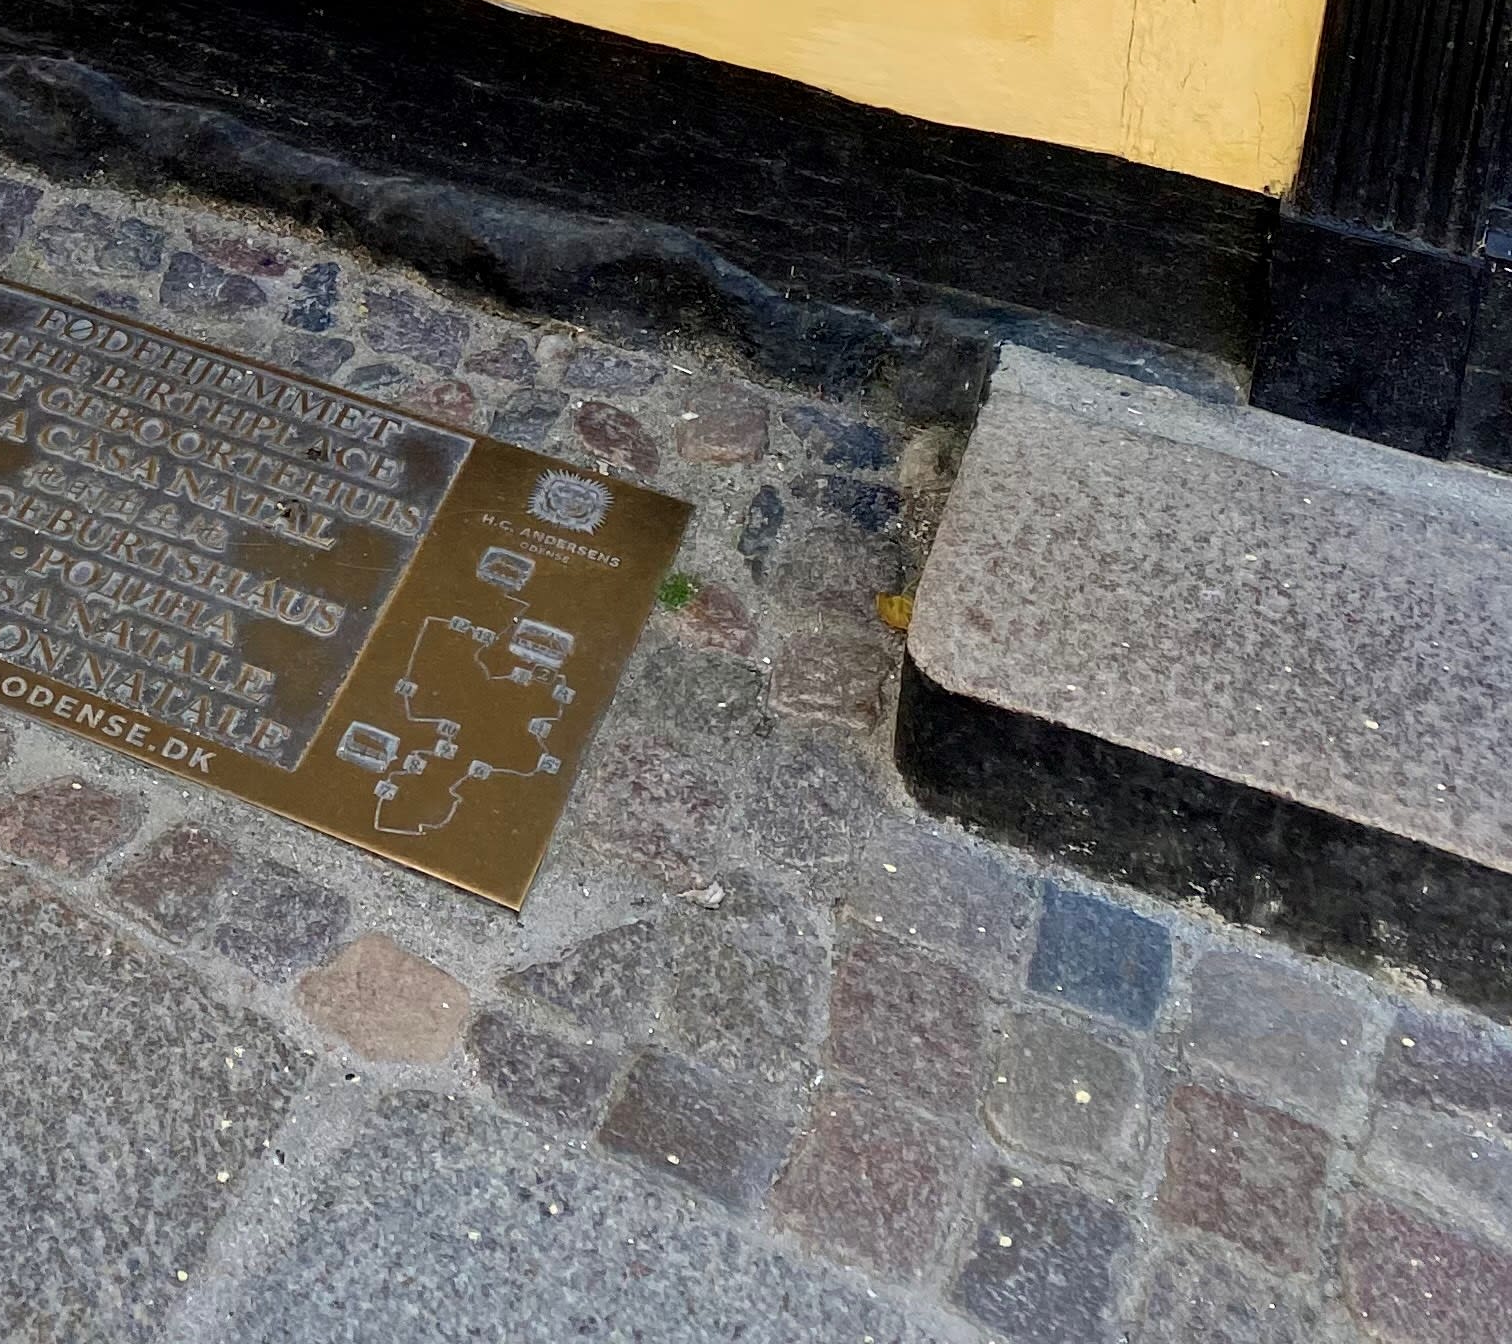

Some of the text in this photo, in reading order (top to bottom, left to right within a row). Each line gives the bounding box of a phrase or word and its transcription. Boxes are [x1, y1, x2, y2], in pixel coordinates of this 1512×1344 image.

[37, 308, 403, 443] FØDEHJEMMET
[94, 365, 401, 485] BIRTHPLACE
[38, 424, 160, 489] CASA
[164, 468, 336, 550] NATAL
[39, 385, 422, 535] GEBOORTEHUIS
[519, 527, 622, 568] ANDERSENS
[519, 541, 571, 565] ODENSE
[55, 597, 274, 703] NATALE
[76, 652, 290, 752] NATALE
